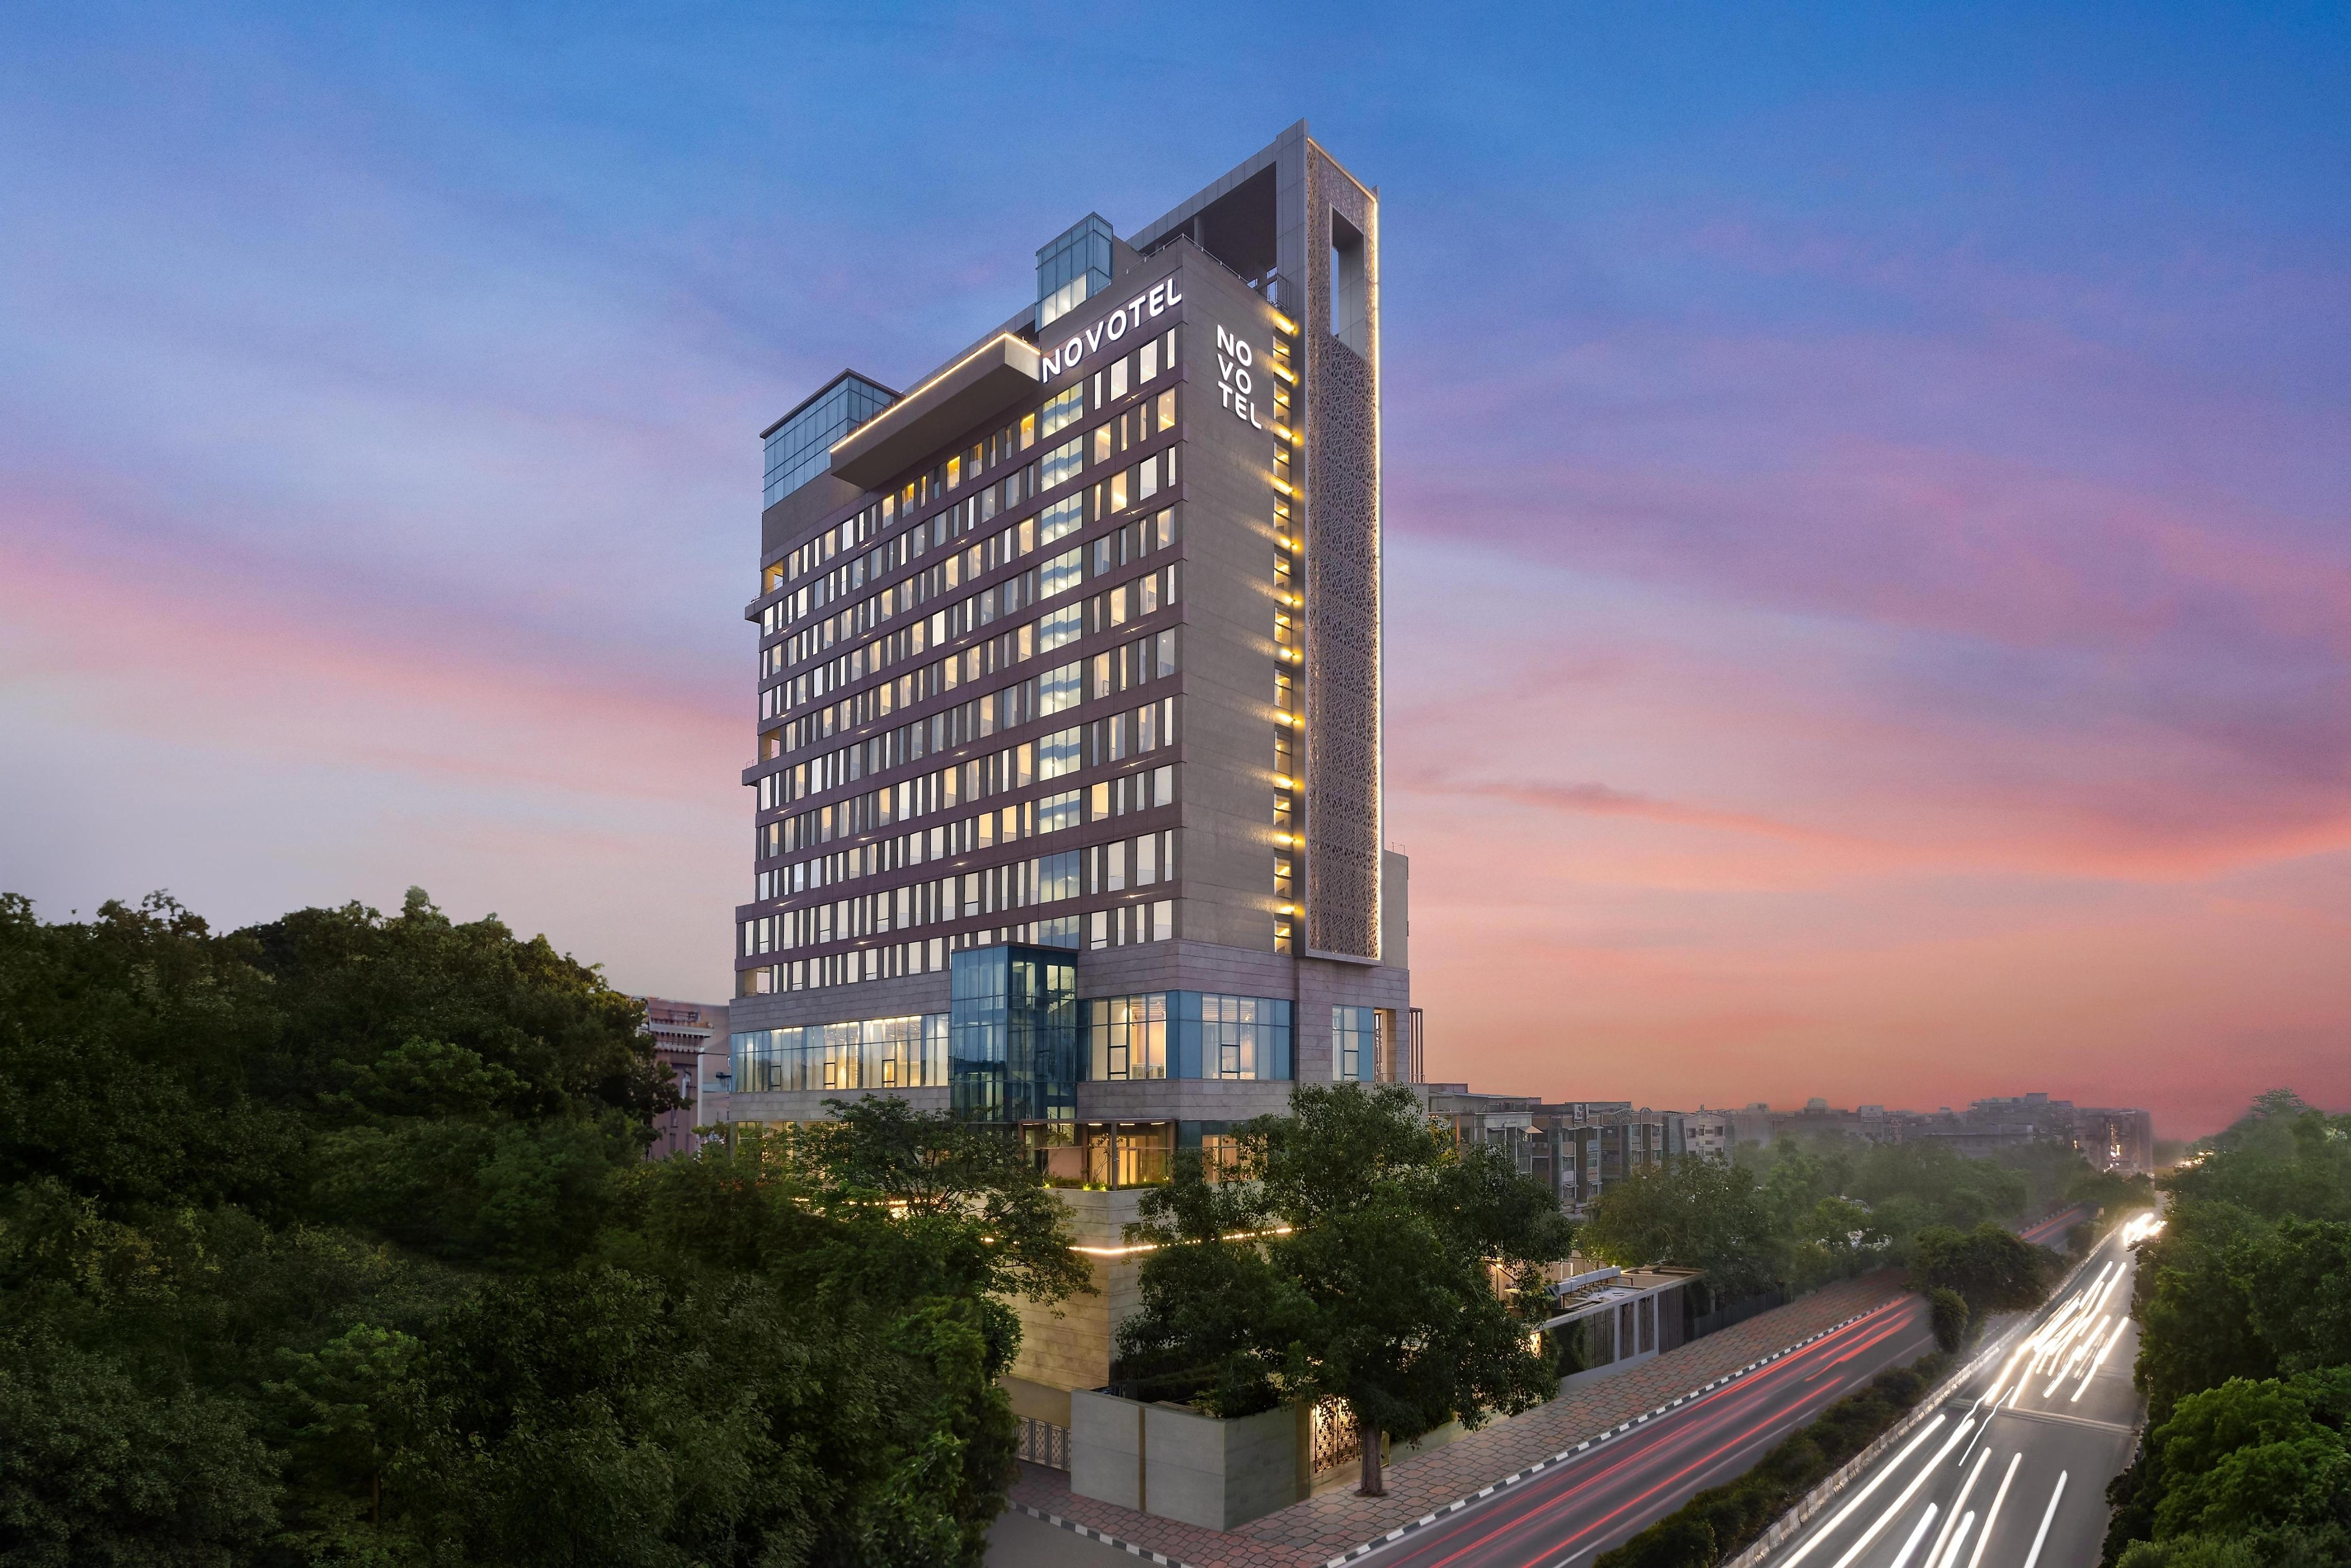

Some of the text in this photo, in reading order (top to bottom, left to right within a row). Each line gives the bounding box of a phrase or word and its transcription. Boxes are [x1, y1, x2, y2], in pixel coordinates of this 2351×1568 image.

[1042, 277, 1182, 384] NOVOTEL
[1217, 324, 1253, 367] NO
[1217, 353, 1252, 395] VO
[1217, 380, 1262, 430] TEL
